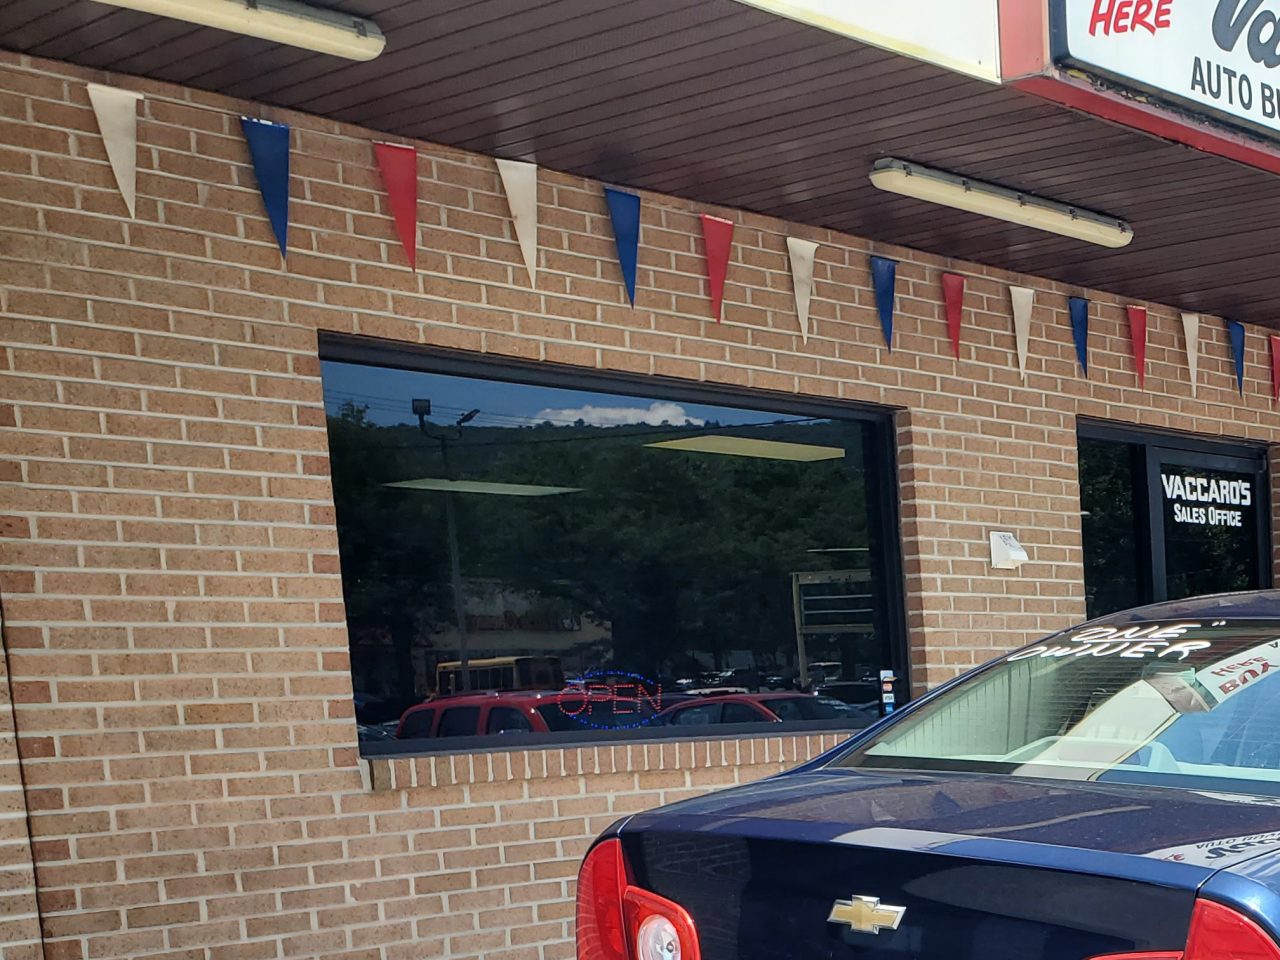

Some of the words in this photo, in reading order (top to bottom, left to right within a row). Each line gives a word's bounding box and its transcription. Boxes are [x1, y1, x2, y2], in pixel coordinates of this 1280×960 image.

[1089, 0, 1171, 37] HERE
[1190, 56, 1253, 111] AUTO
[1161, 474, 1251, 506] VACCARO'S
[1174, 503, 1206, 525] SALES
[1208, 506, 1242, 527] OFFICE
[1071, 623, 1202, 642] ONE
[1007, 639, 1211, 661] OWNER
[558, 683, 662, 715] OPEN
